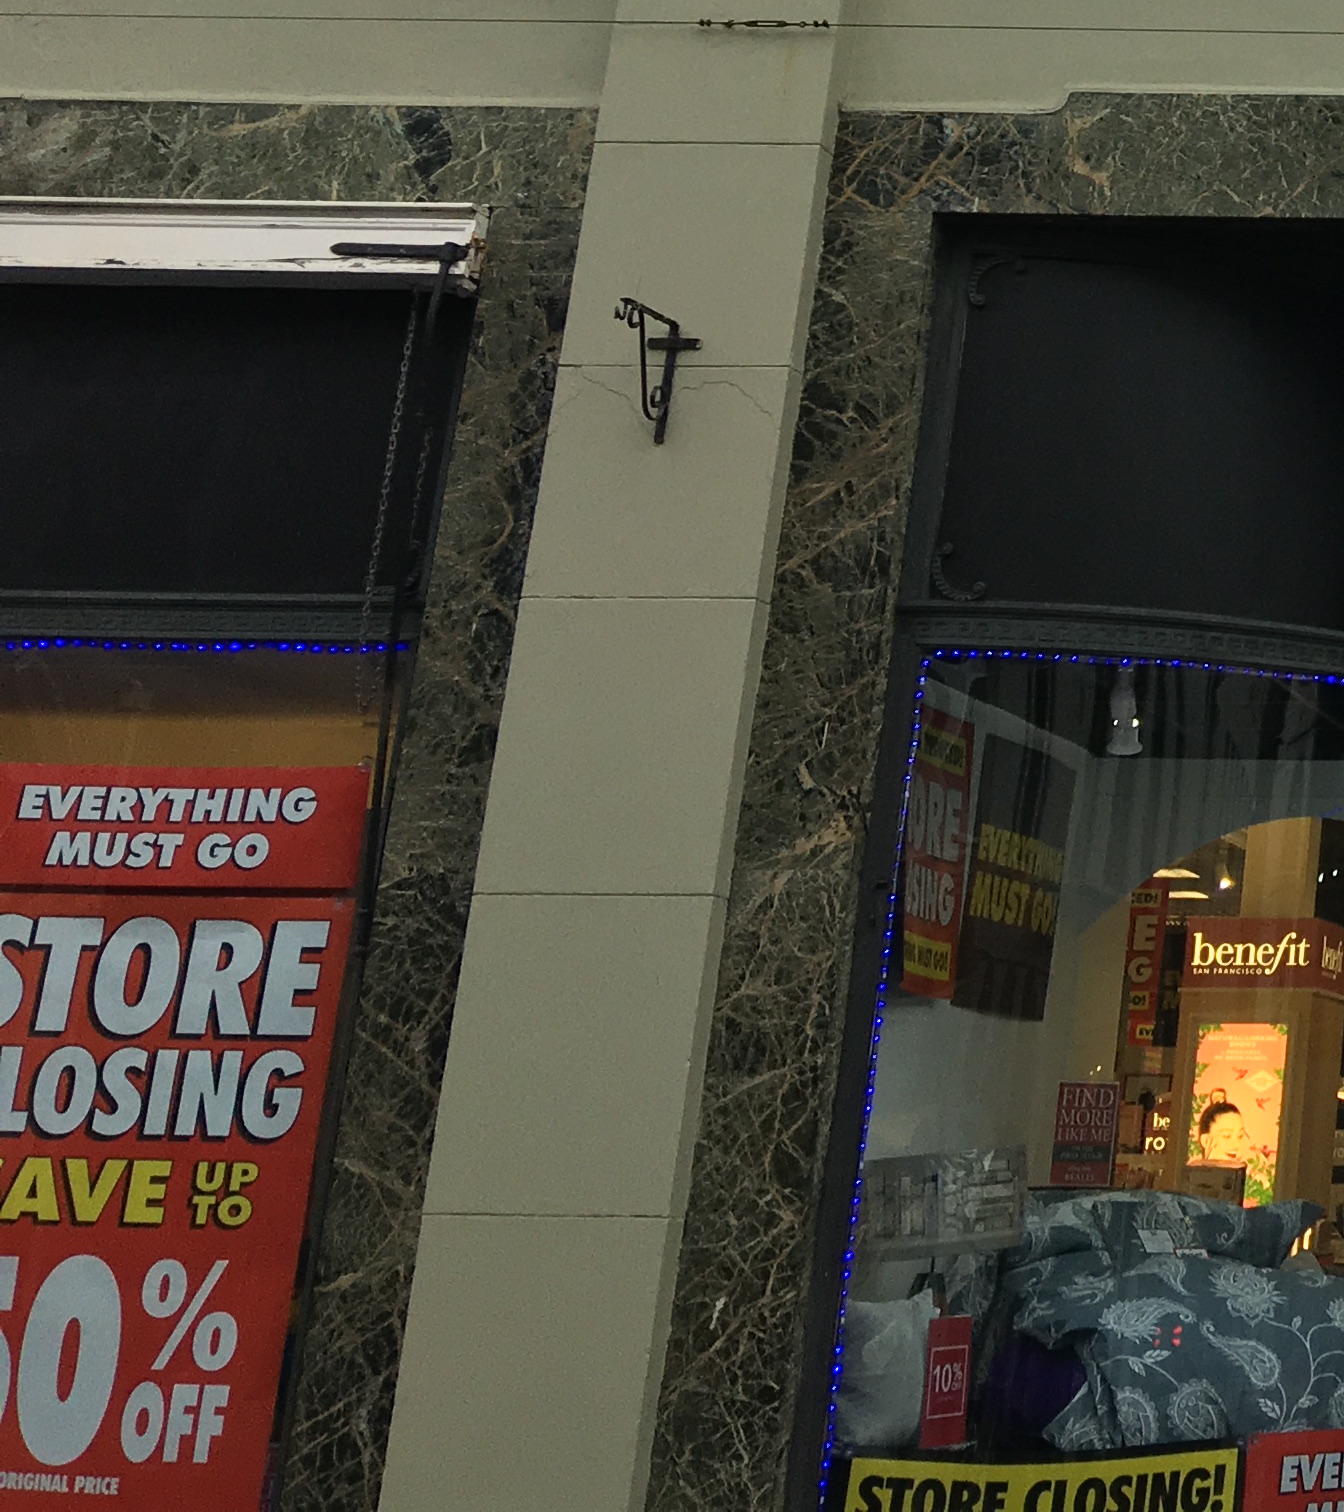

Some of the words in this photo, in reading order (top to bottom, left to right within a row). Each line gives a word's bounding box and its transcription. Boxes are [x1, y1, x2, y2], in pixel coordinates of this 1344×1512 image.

[18, 785, 318, 824] EVERYTHING
[45, 831, 184, 869] MUST
[195, 833, 270, 870] GO
[969, 871, 1031, 927] MUST
[1191, 931, 1311, 975] benefit
[1213, 968, 1263, 976] FRANCISCO
[1061, 1087, 1115, 1108] FIND
[1057, 1127, 1089, 1142] LIKE
[1090, 1127, 1113, 1143] ME
[1058, 1109, 1114, 1127] MORE
[0, 1156, 173, 1228] AVE
[195, 1162, 258, 1194] UP
[191, 1194, 253, 1229] TO
[120, 1381, 231, 1464] OFF
[73, 1475, 120, 1496] PRICE
[1025, 1462, 1226, 1512] CLOSING!
